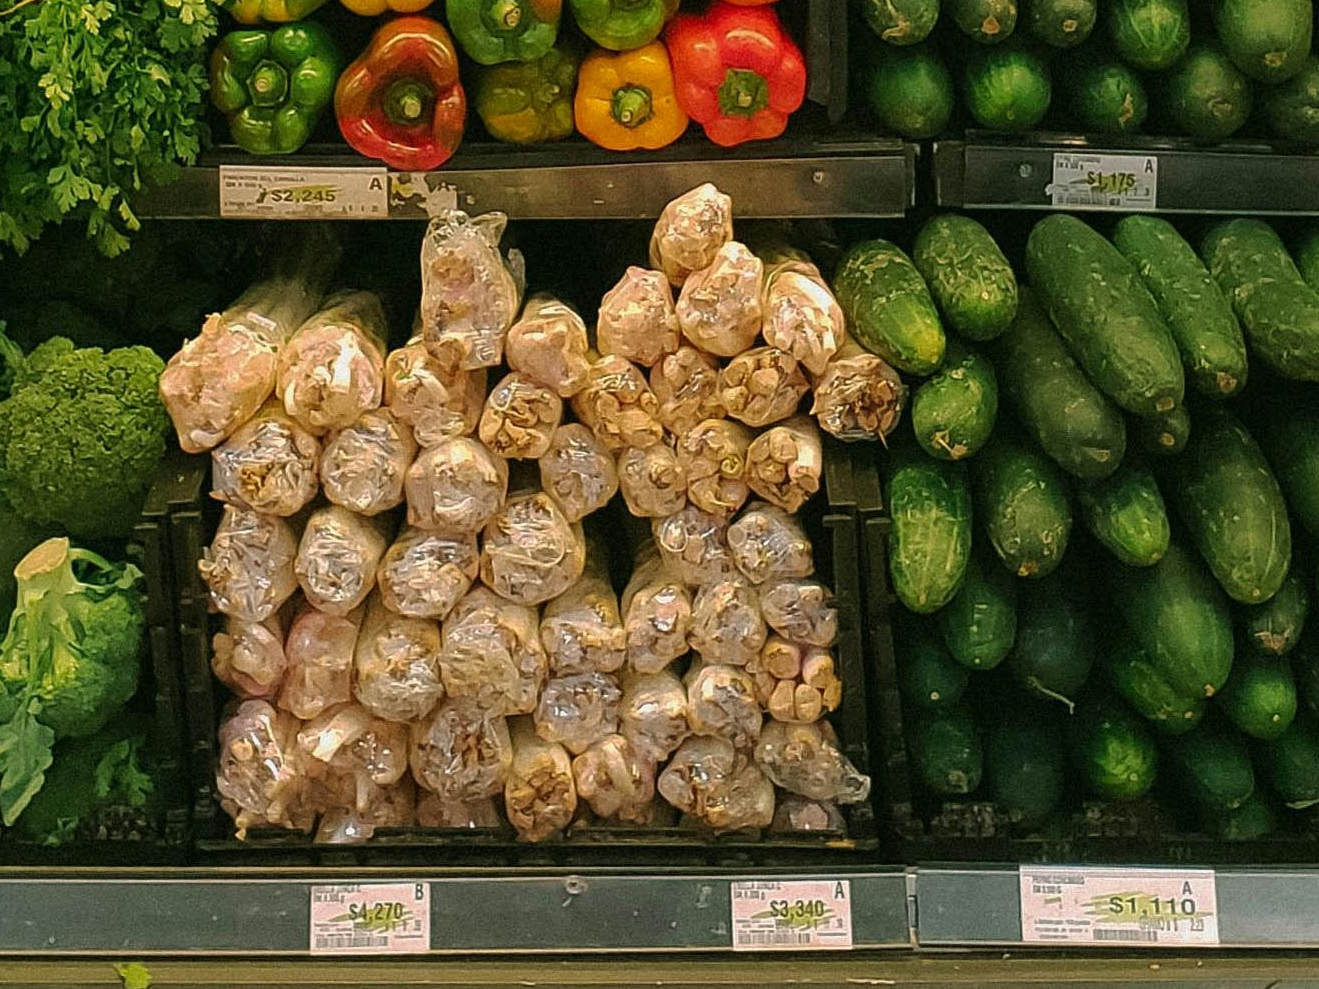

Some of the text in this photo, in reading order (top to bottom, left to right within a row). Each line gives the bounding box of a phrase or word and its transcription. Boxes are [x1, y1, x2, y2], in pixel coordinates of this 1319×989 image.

[1145, 158, 1154, 173] A
[369, 177, 383, 190] A
[271, 189, 336, 204] $2,245
[415, 883, 424, 900] B
[834, 881, 845, 899] A
[1182, 880, 1193, 895] A
[348, 902, 403, 923] $4,270
[770, 899, 825, 919] $3,340
[1109, 896, 1196, 916] $1,110
